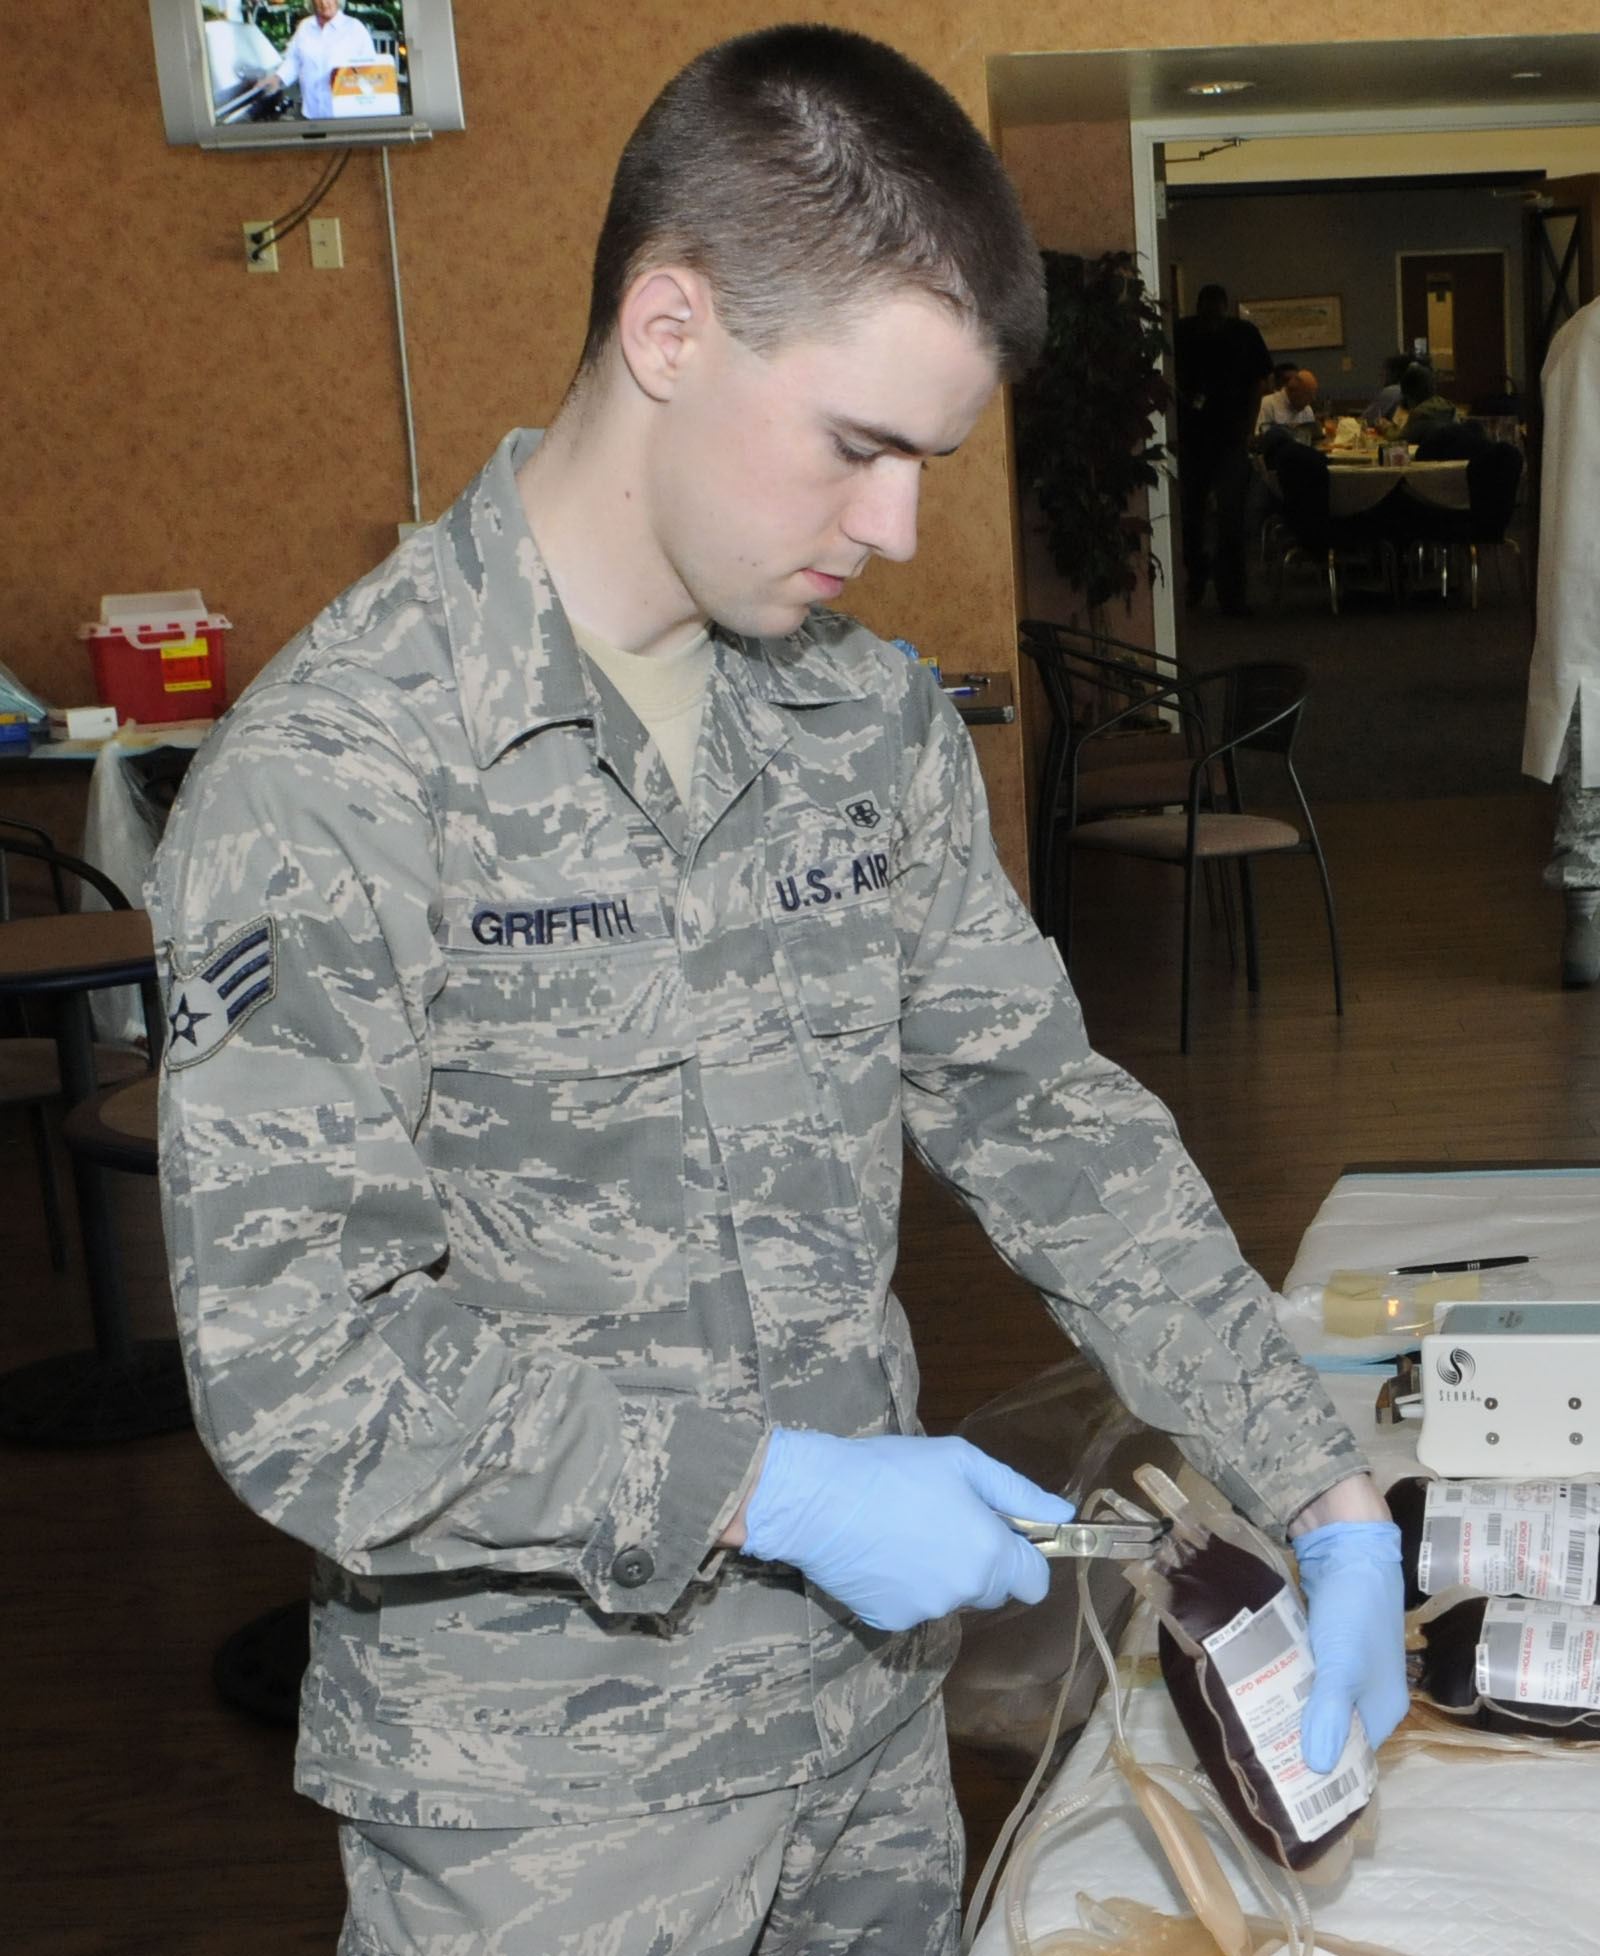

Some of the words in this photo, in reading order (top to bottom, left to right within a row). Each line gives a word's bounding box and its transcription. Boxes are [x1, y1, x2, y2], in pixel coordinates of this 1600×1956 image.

[775, 869, 841, 912] U.S.
[851, 853, 889, 895] AIR
[472, 899, 637, 945] GRIFFITH
[1463, 1521, 1473, 1546] BLOOD
[1235, 1681, 1254, 1697] CPD
[1255, 1664, 1280, 1685] WHOLE
[1280, 1650, 1298, 1668] BLOOD
